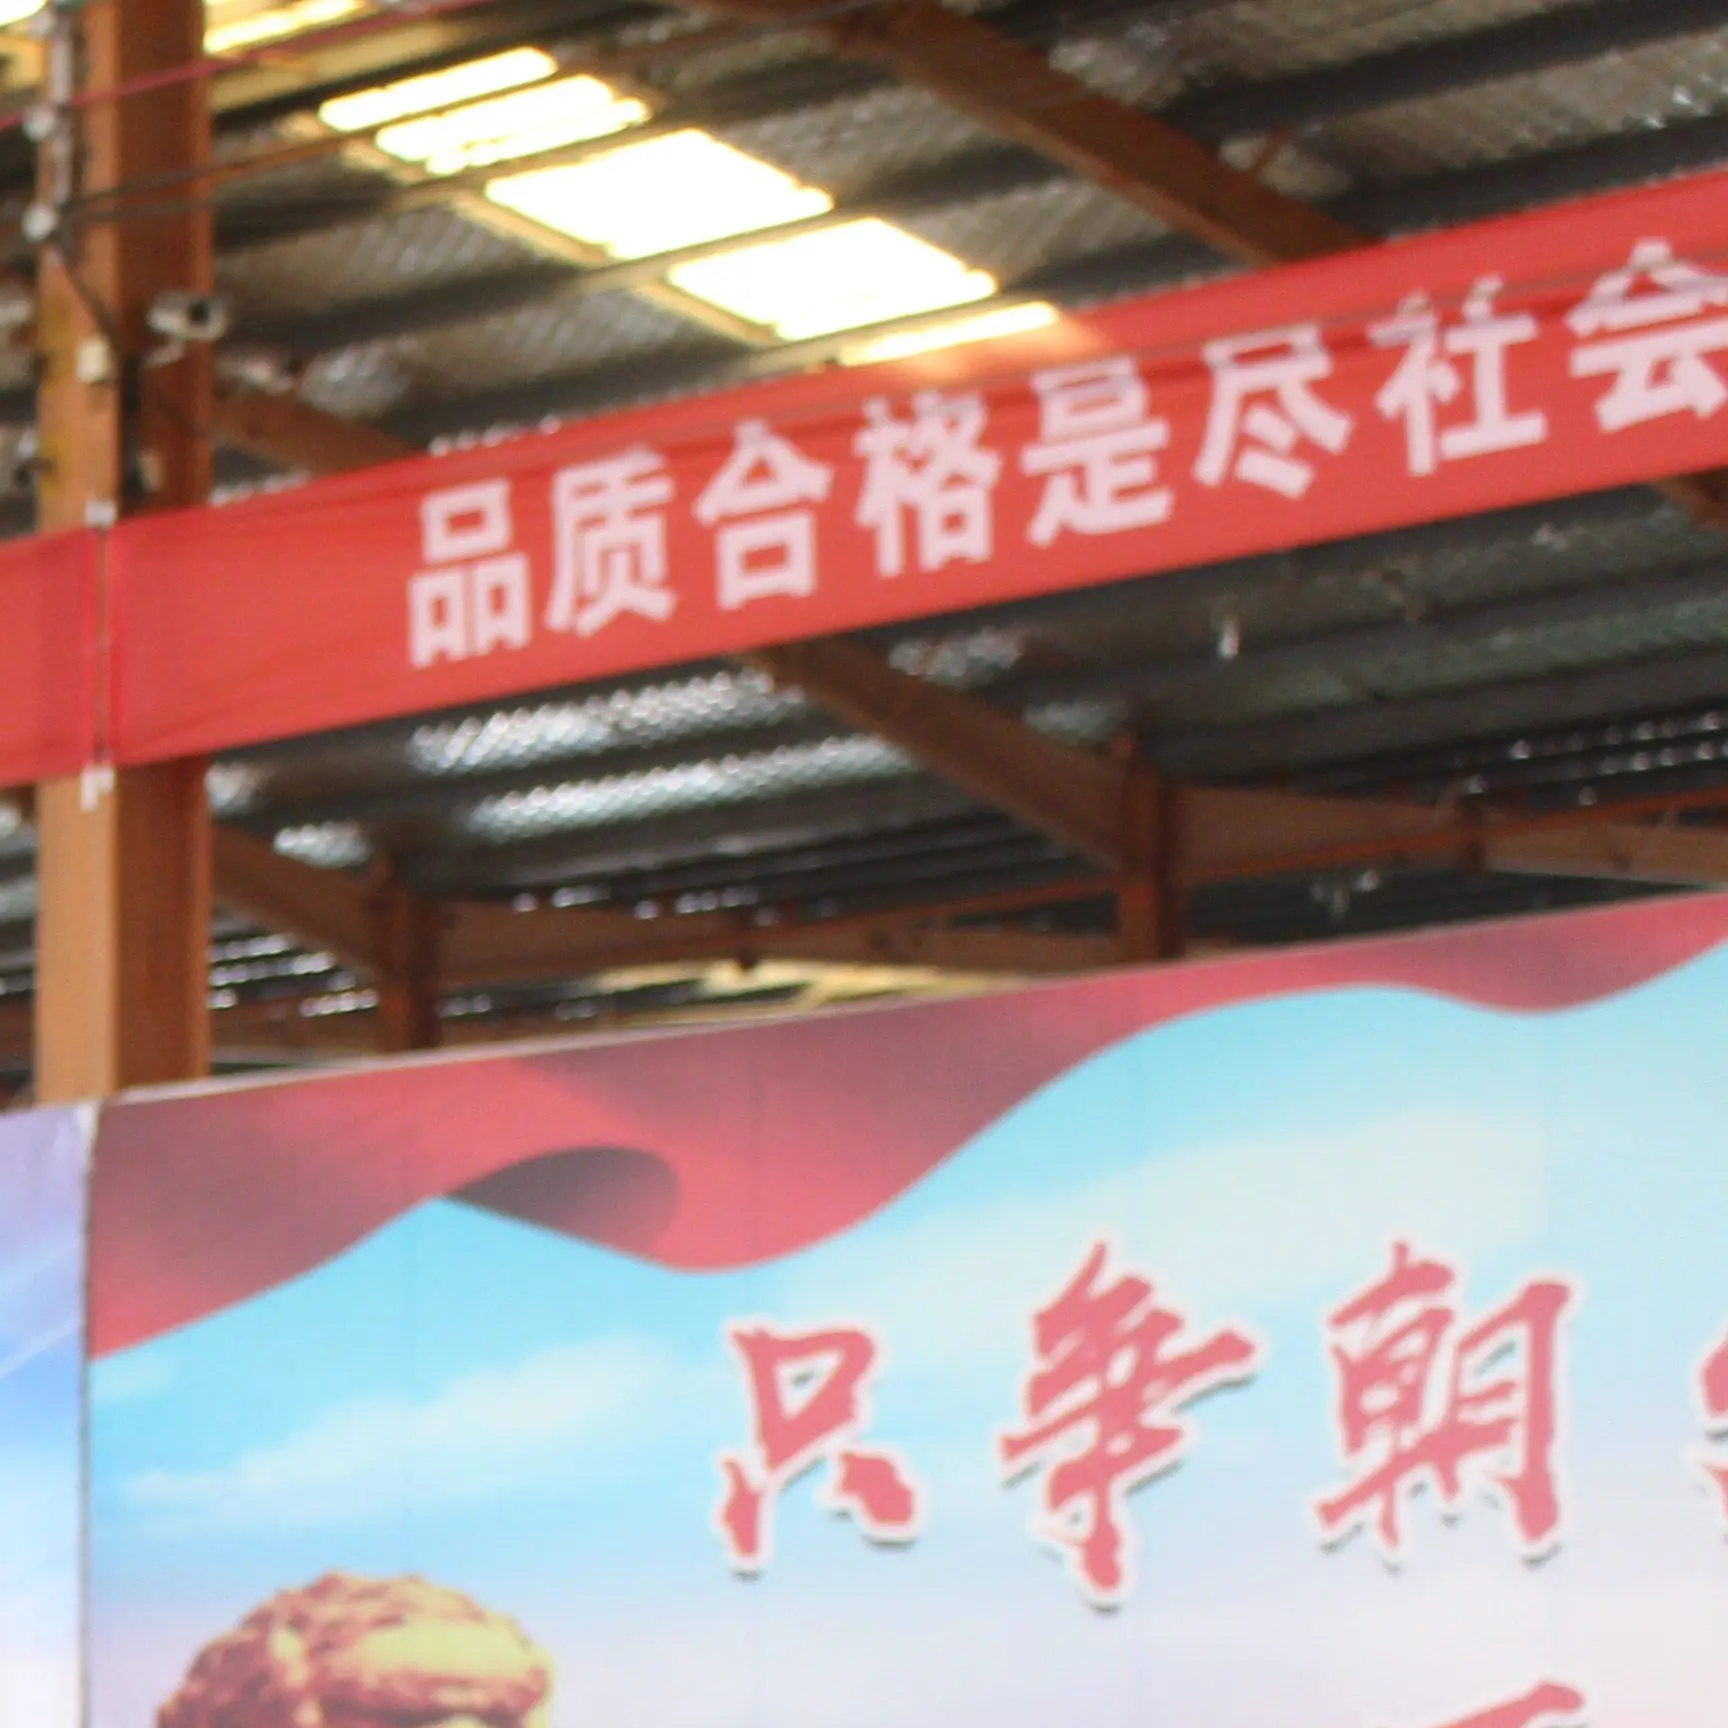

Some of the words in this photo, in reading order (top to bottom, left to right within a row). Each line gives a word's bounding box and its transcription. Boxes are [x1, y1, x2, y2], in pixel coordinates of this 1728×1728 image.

[406, 236, 1728, 668] 品质合格是尽社会
[720, 1240, 1728, 1595] 只争朝
